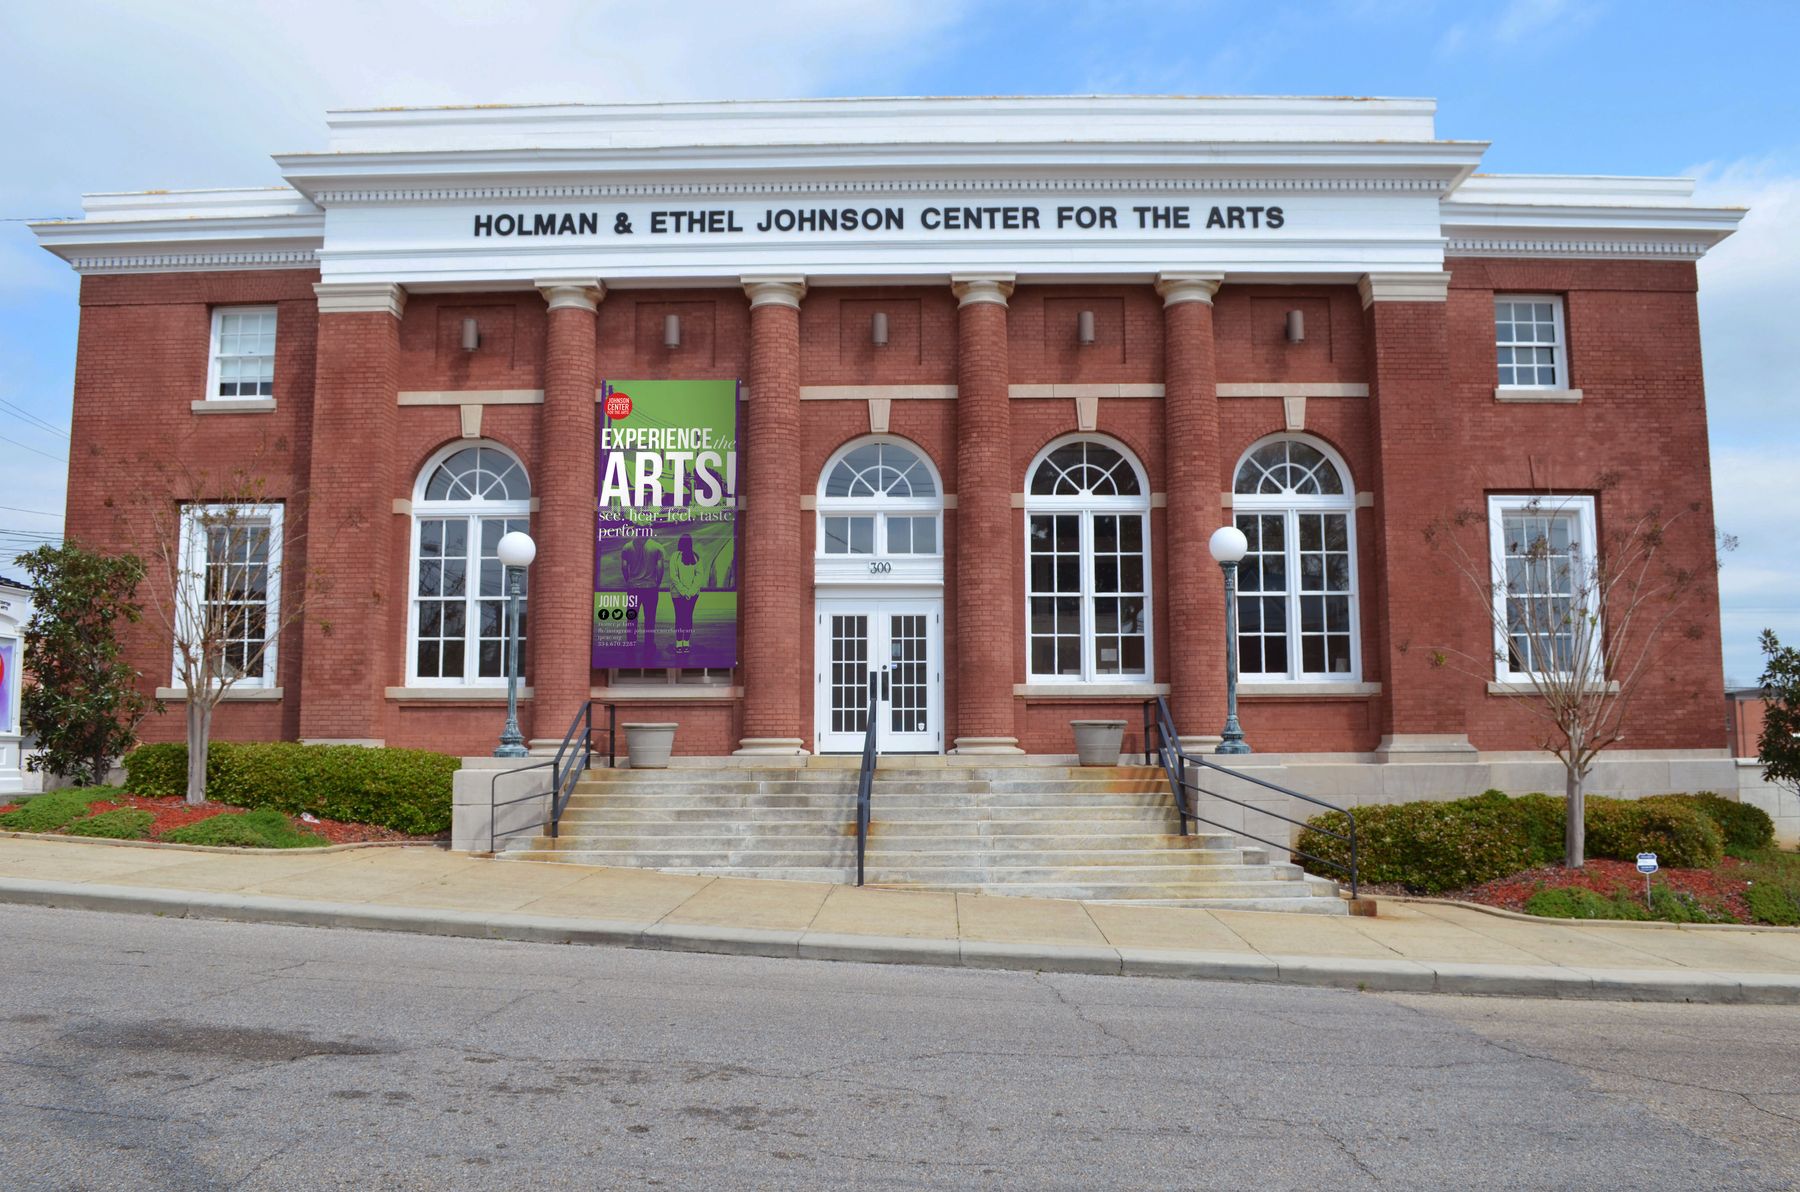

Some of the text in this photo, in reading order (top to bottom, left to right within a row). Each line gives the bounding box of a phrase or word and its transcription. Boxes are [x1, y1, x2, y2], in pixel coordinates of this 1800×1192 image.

[475, 206, 1284, 236] HOLMAN & ETHEL JOHNSON CENTER FOR THE ARTS
[601, 428, 736, 449] EXPERIENCE the
[600, 451, 736, 507] ARTS!
[599, 508, 735, 521] see. hear. feel. taste.
[599, 524, 658, 541] perform.
[870, 561, 891, 574] 300
[599, 595, 638, 608] JOIN US!
